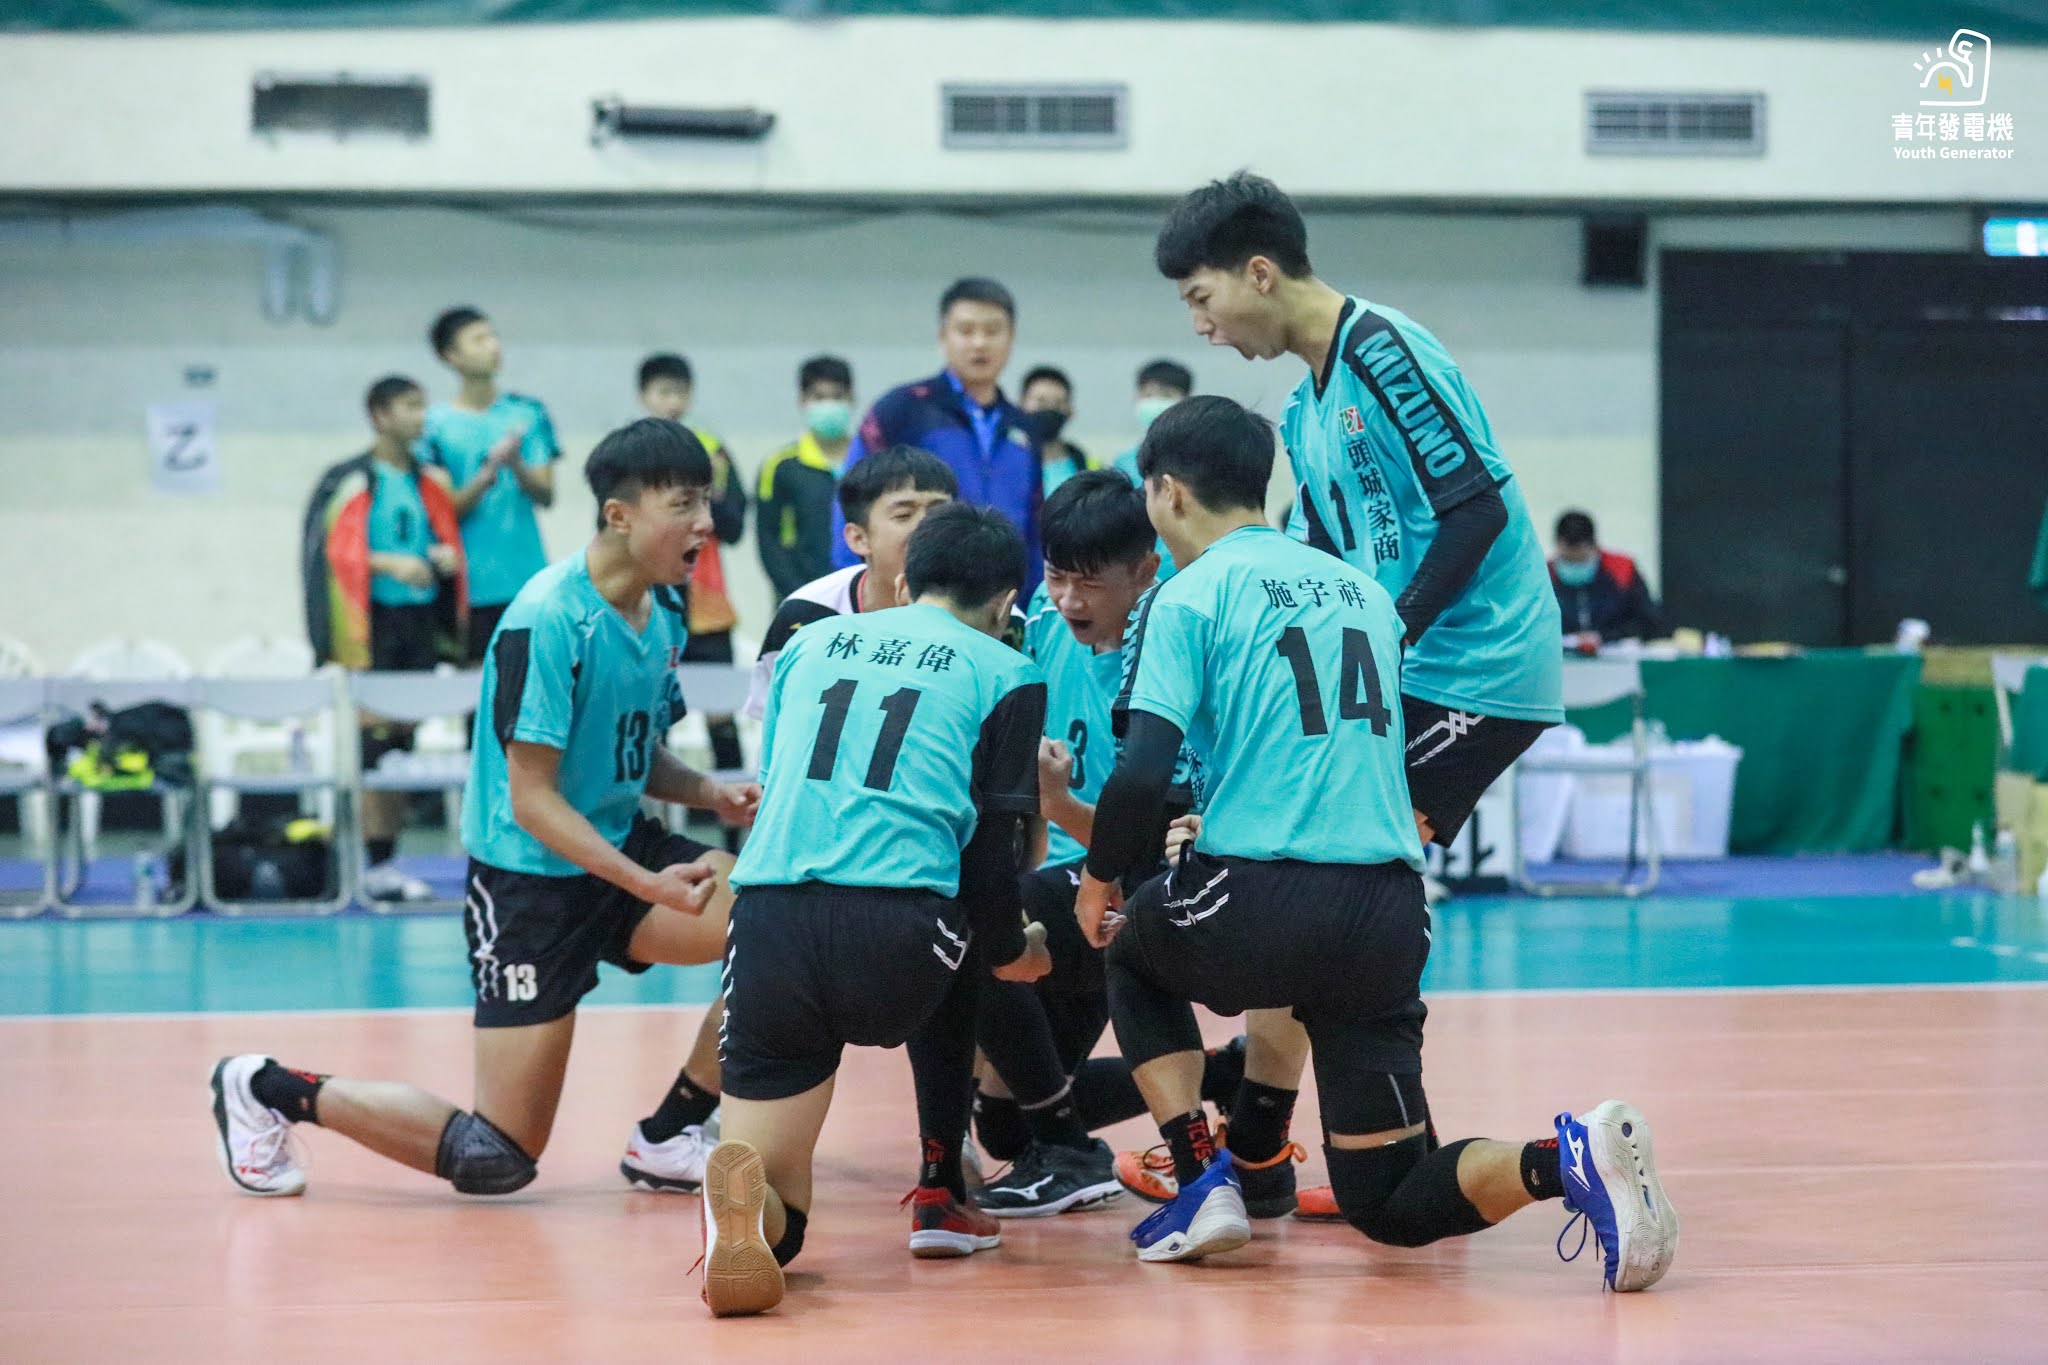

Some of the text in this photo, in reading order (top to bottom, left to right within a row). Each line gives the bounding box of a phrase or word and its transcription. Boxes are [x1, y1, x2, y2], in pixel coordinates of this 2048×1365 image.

[1354, 329, 1466, 479] MIZUNO
[1329, 480, 1356, 552] 1
[1347, 437, 1400, 566] 頭城家商
[1260, 578, 1367, 609] 施宇祥
[824, 632, 956, 672] 林嘉偉
[1276, 626, 1392, 738] 14
[615, 709, 650, 783] 13
[806, 678, 922, 792] 11
[503, 963, 538, 1002] 13
